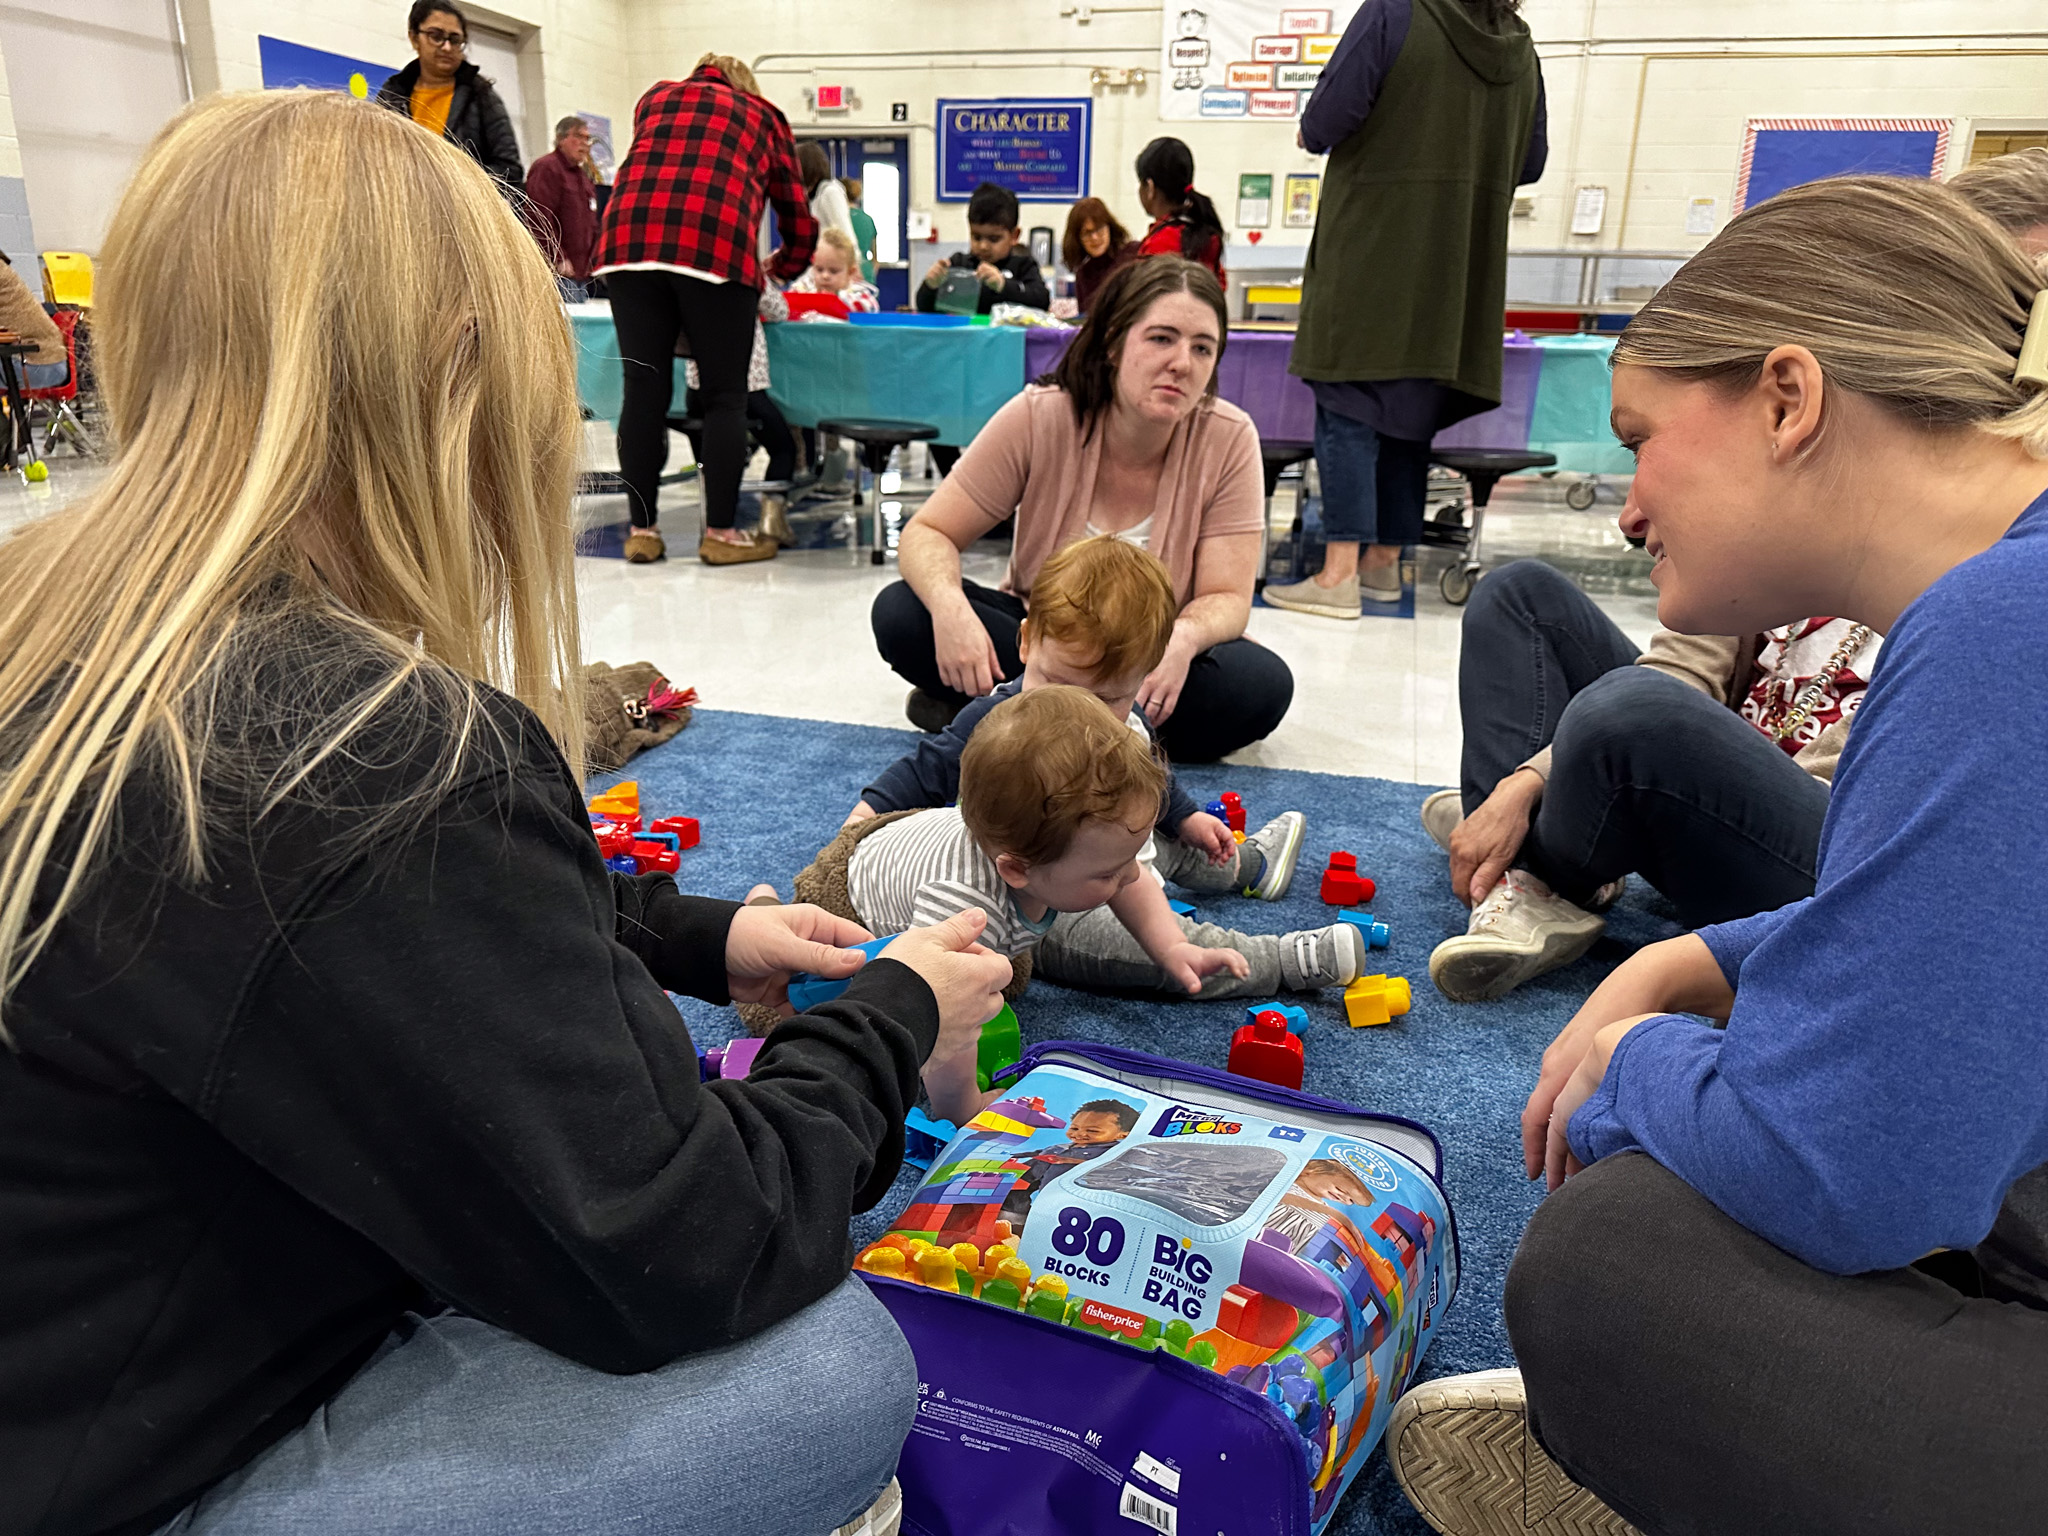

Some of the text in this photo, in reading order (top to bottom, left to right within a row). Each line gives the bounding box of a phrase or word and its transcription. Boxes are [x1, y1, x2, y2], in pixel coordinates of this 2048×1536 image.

[895, 105, 904, 120] 2
[954, 111, 1070, 132] CHARACTER
[1175, 1109, 1219, 1122] MEGA
[1162, 1121, 1243, 1137] BLOKS
[1348, 1154, 1374, 1176] USA
[1354, 1145, 1390, 1173] JUNIOR
[1051, 1206, 1125, 1267] 80
[1044, 1256, 1111, 1287] BLOCKS
[1150, 1266, 1207, 1299] BUILDING
[1142, 1278, 1202, 1320] BAG
[1085, 1305, 1141, 1330] fisher-price
[952, 1397, 978, 1410] CONFORMS
[985, 1405, 994, 1414] THE
[994, 1408, 1011, 1419] SAFETY
[1011, 1413, 1046, 1429] REQUIREMENTS
[1052, 1425, 1067, 1435] ASTM
[1150, 1465, 1159, 1475] PT
